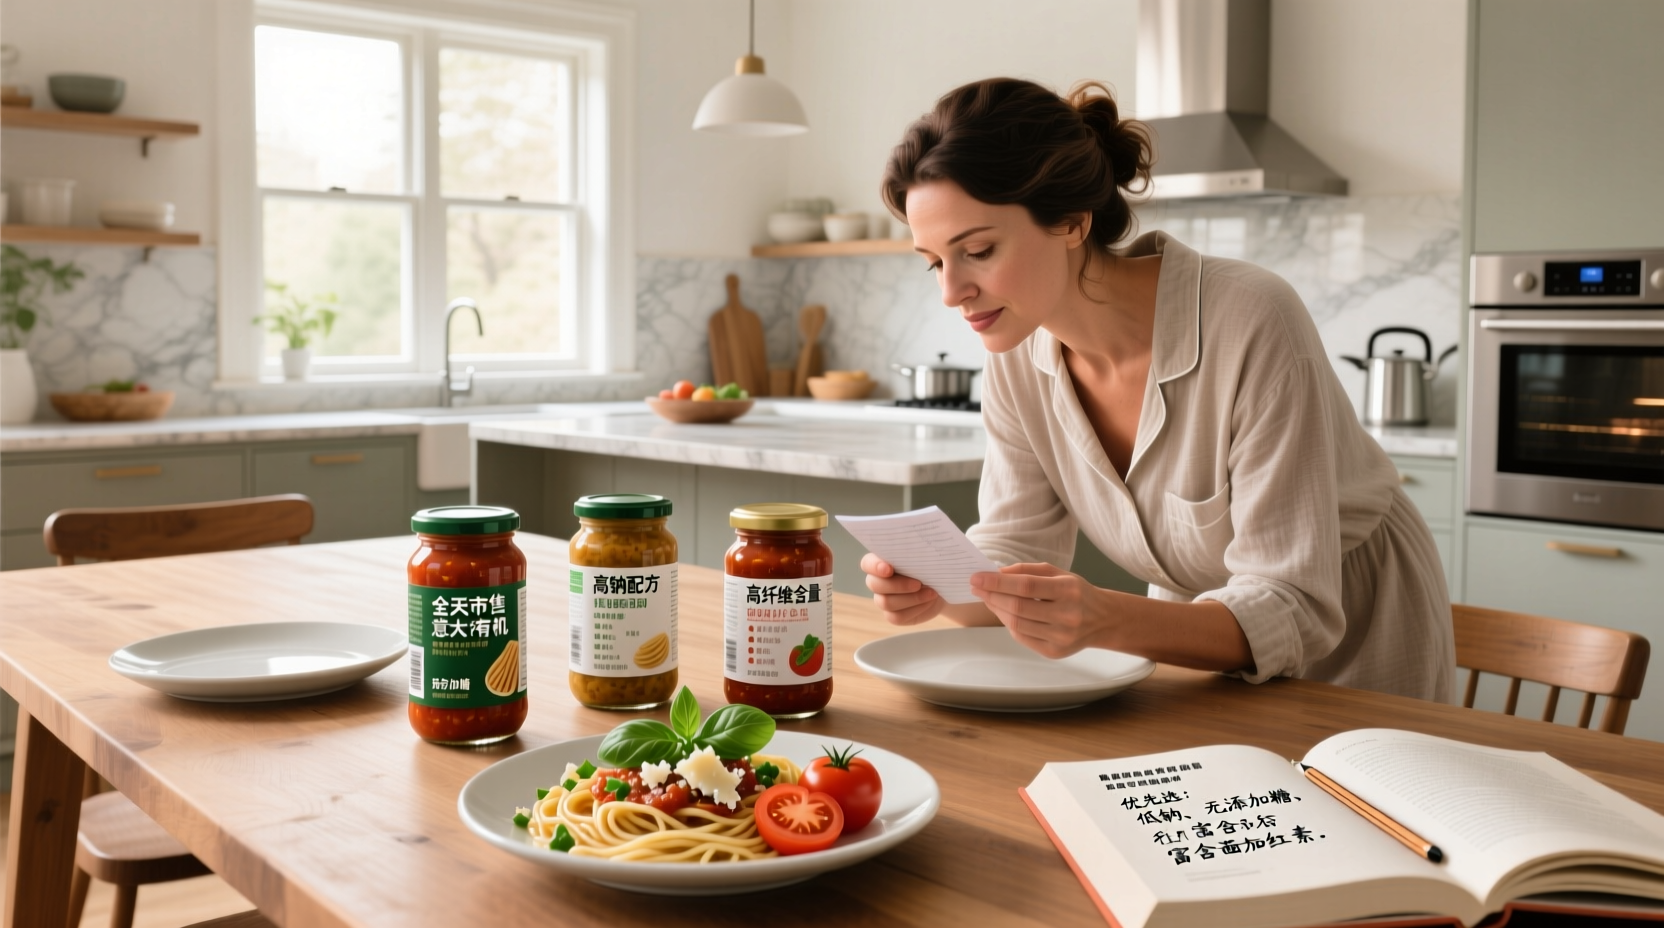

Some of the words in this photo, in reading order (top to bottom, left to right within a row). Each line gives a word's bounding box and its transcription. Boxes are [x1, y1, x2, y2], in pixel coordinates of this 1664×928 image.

[593, 574, 661, 594] 高钠配方
[746, 583, 822, 605] 高纤维含量
[431, 593, 506, 617] 全天市售
